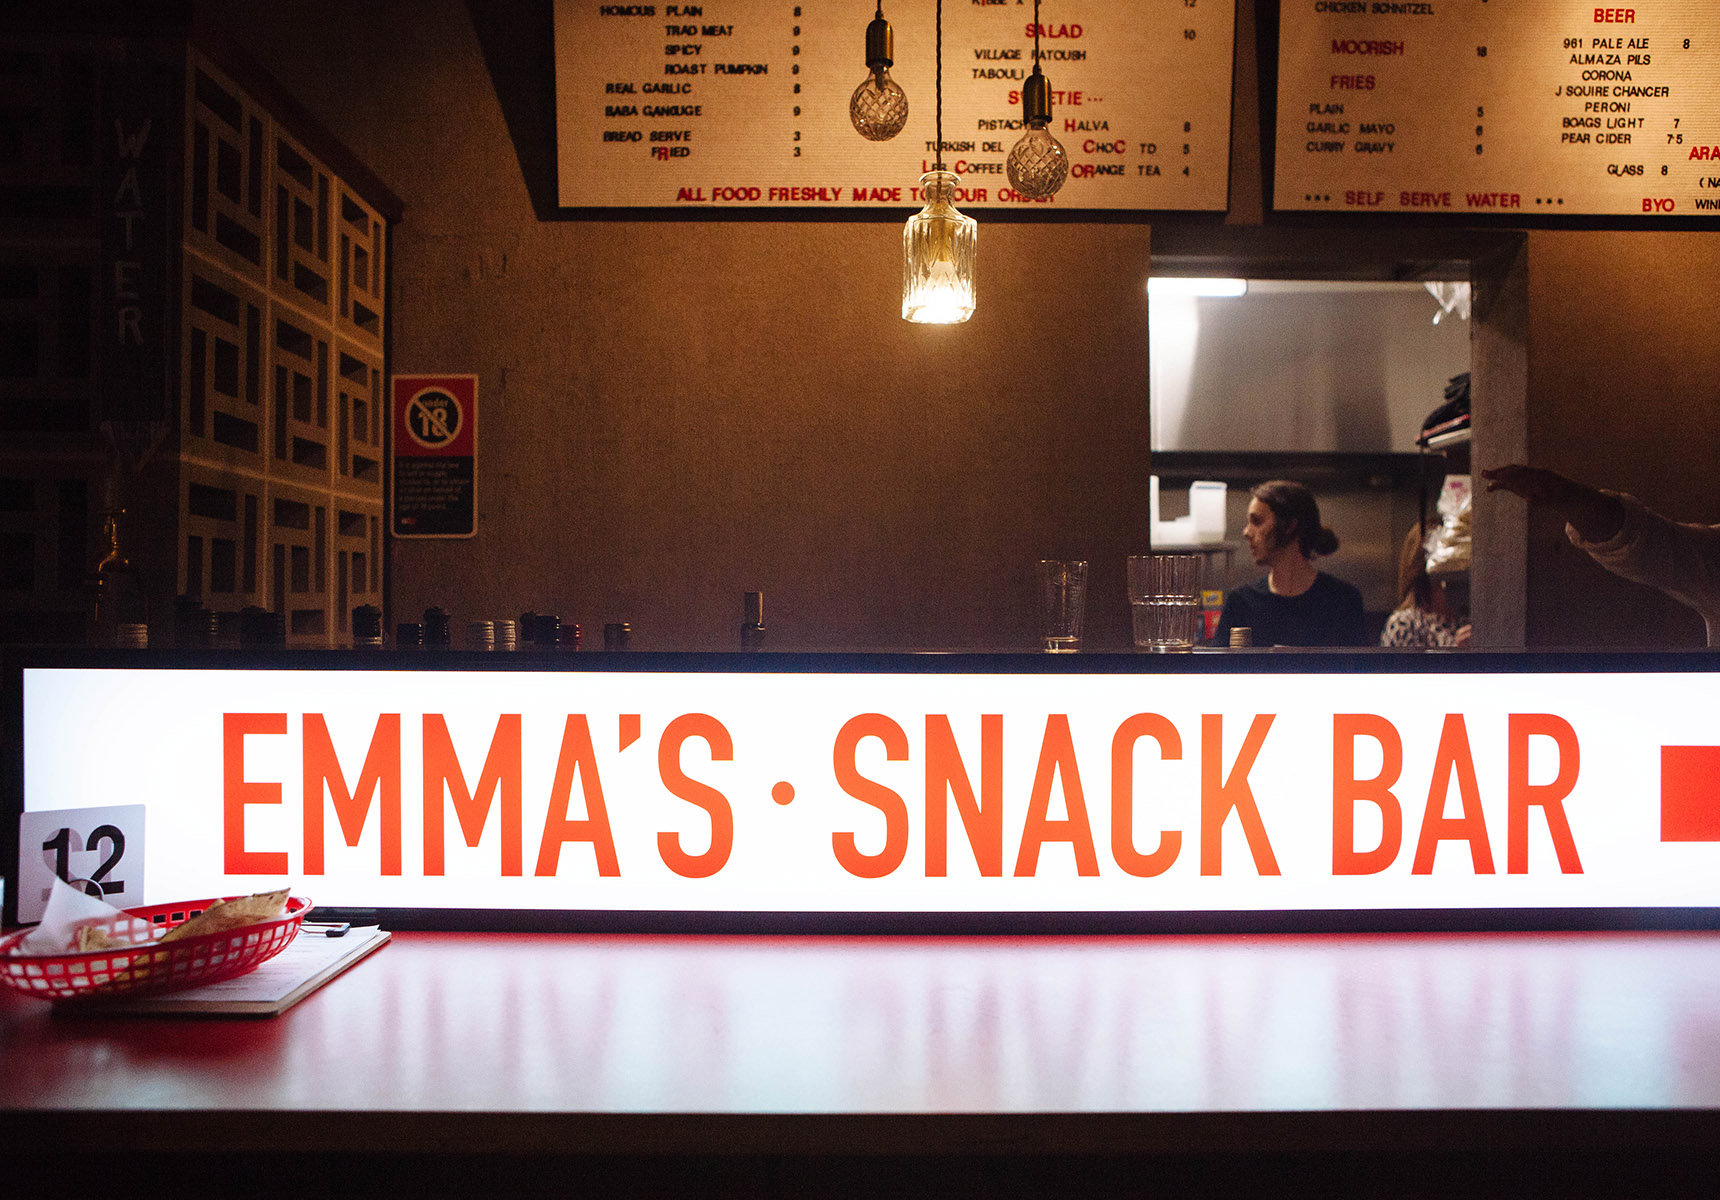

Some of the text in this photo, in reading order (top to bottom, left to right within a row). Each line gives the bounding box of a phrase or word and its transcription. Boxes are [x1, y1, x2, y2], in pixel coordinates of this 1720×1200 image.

[600, 5, 801, 17] HOMOUS PLAIN 8
[1315, 1, 1434, 15] CHICKEN SCHNITZEL
[1593, 8, 1636, 23] BEER
[665, 25, 801, 36] TRAD MEAT 9
[1025, 23, 1083, 38] SALAD
[1184, 29, 1196, 40] 10
[665, 44, 702, 55] SPICY
[1331, 39, 1404, 56] MOORISH
[1563, 38, 1690, 49] 961 PALE ALE 8
[974, 49, 1022, 60] VILLAGE
[1569, 54, 1651, 65] ALMAZA PILS
[665, 64, 799, 75] ROAST PUMPKIN 9
[972, 68, 1024, 80] TABOULI
[1581, 70, 1632, 82] CORONA
[605, 83, 637, 94] REAL
[642, 83, 692, 94] GARLIC
[1330, 75, 1376, 90] FRIES
[1008, 90, 1083, 105] SETIE
[1555, 86, 1670, 98] J SQUIRE CHANCER
[605, 105, 638, 117] BABA
[1309, 103, 1344, 115] PLAIN
[1585, 102, 1630, 113] PERONI
[1064, 118, 1109, 132] HALVA
[1306, 122, 1350, 134] GARLIC
[1359, 123, 1395, 135] MAYO
[1562, 117, 1680, 129] BOAGS LIGHT 7
[603, 131, 801, 142] BREAD SERVE 3
[1561, 133, 1591, 144] PEAR
[1596, 133, 1632, 144] CIDER
[925, 141, 975, 152] TURKISH
[982, 141, 1004, 152] DEL
[1306, 141, 1345, 152] CURRY
[1355, 141, 1395, 153] GRAVY
[651, 146, 801, 161] FRIED 3
[955, 160, 1003, 174] COFFEE
[1071, 164, 1125, 178] ORANGE
[1137, 165, 1161, 176] TEA
[1183, 166, 1189, 176] 4
[1607, 164, 1668, 177] GLASS 8
[676, 187, 707, 202] ALL
[712, 187, 762, 202] FOOD
[768, 187, 842, 202] FRESHLY
[852, 187, 902, 202] MADE
[953, 187, 988, 202] OUR
[1345, 190, 1521, 208] SELF SERVE WATER
[1642, 198, 1720, 212] BYO WIN
[116, 119, 153, 345] WATER
[418, 408, 448, 436] 18
[223, 712, 1584, 878] EMMA'S SNACK BAR
[42, 824, 125, 894] 12
